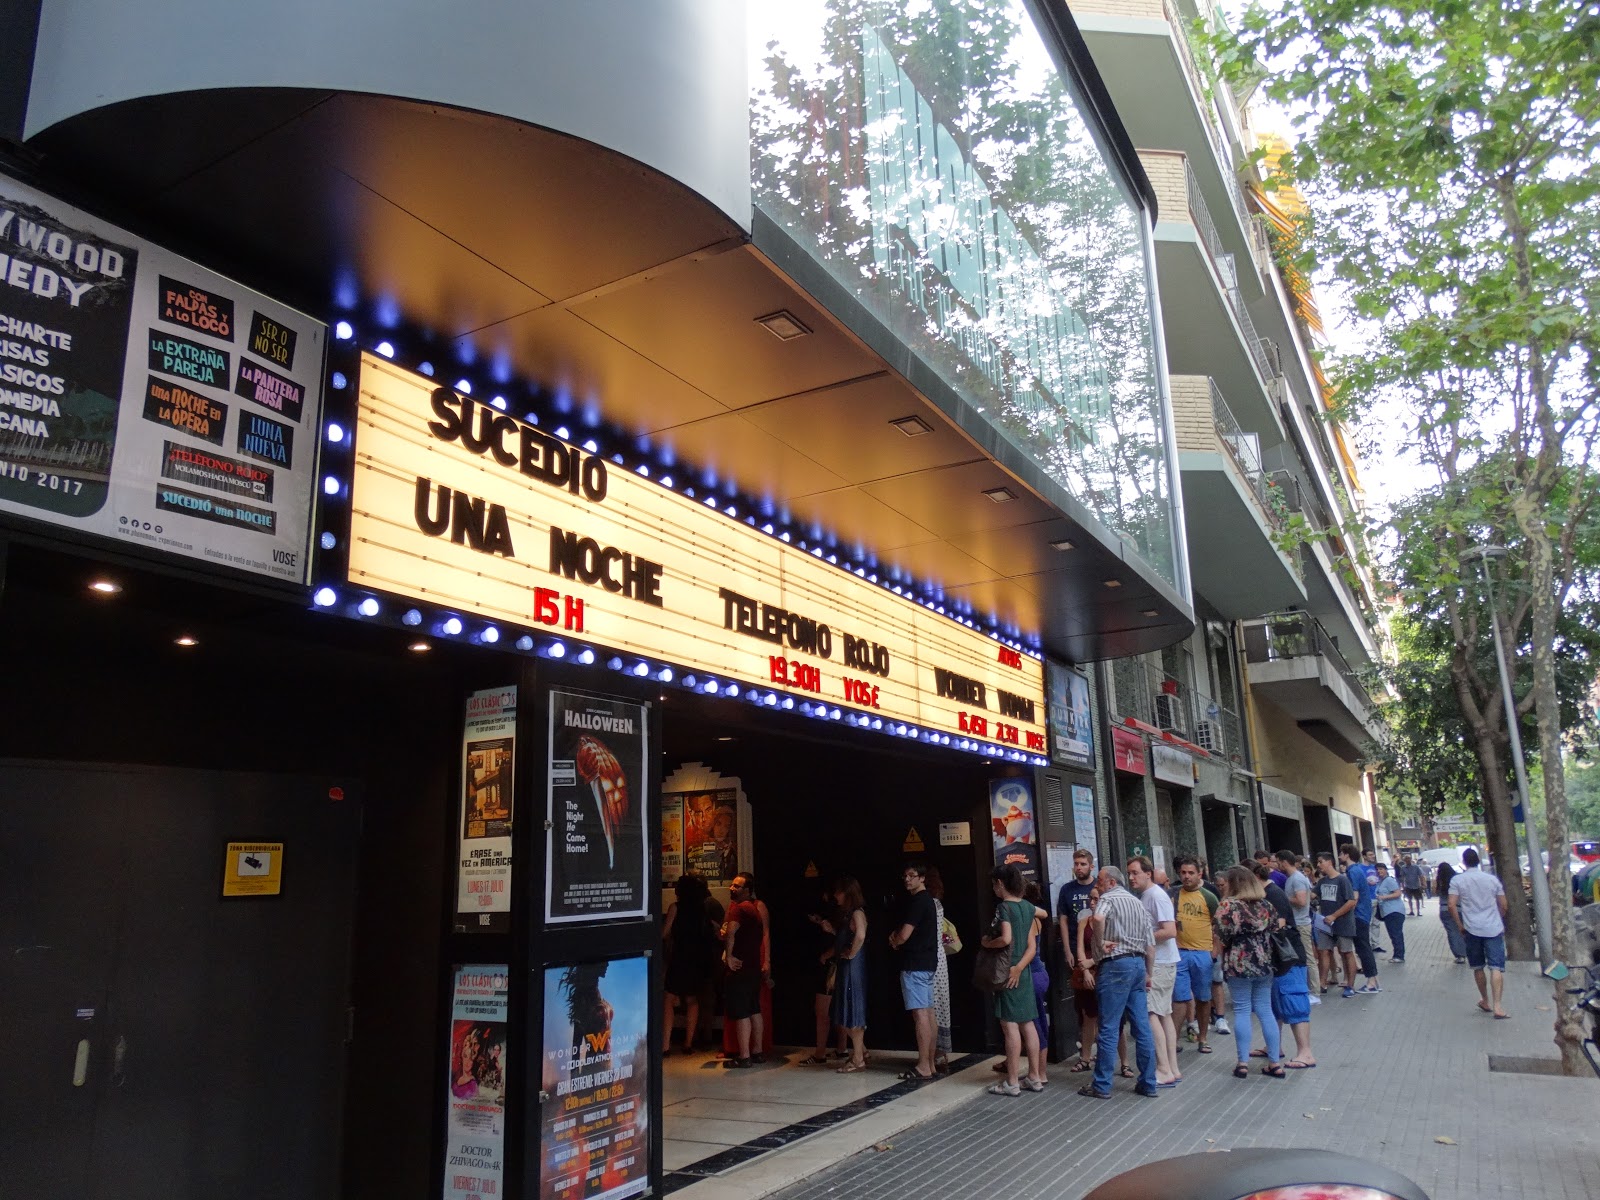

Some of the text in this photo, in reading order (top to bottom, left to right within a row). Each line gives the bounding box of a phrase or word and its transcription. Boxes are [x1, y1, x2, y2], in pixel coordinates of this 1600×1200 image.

[166, 290, 228, 323] FALDAS Y
[189, 290, 208, 304] CON
[165, 308, 230, 336] A LO LOCO
[261, 320, 288, 346] SER O
[152, 340, 226, 370] LA EXTRAÑA
[254, 335, 288, 365] NO SER
[163, 355, 214, 383] PAREJA
[241, 366, 299, 403] LA PANTERA
[254, 384, 282, 411] ROSA
[158, 406, 170, 420] LA
[251, 416, 283, 443] LUNA
[245, 433, 287, 463] NUEVA
[427, 386, 608, 503] SUCEDIO
[37, 471, 83, 496] 2017
[174, 464, 208, 478] VOLAMOS
[236, 465, 267, 482] ROJO?
[162, 491, 212, 513] SUCEDIÓ
[236, 508, 272, 527] NOCHE
[414, 476, 663, 608] UNA NOCHE
[272, 549, 296, 567] VOSE
[718, 586, 890, 678] TELEFONO ROJO
[843, 676, 880, 710] VOSE
[934, 666, 1035, 724] WONDER WOMAN
[564, 709, 634, 734] HALLOWEEN
[565, 801, 578, 810] The
[566, 811, 584, 822] Night
[566, 822, 576, 831] He
[566, 833, 586, 842] Came
[566, 843, 589, 853] Home!
[461, 859, 472, 868] VEZ
[449, 1156, 484, 1168] ZHIVAGO
[461, 1144, 493, 1157] DOCTOR
